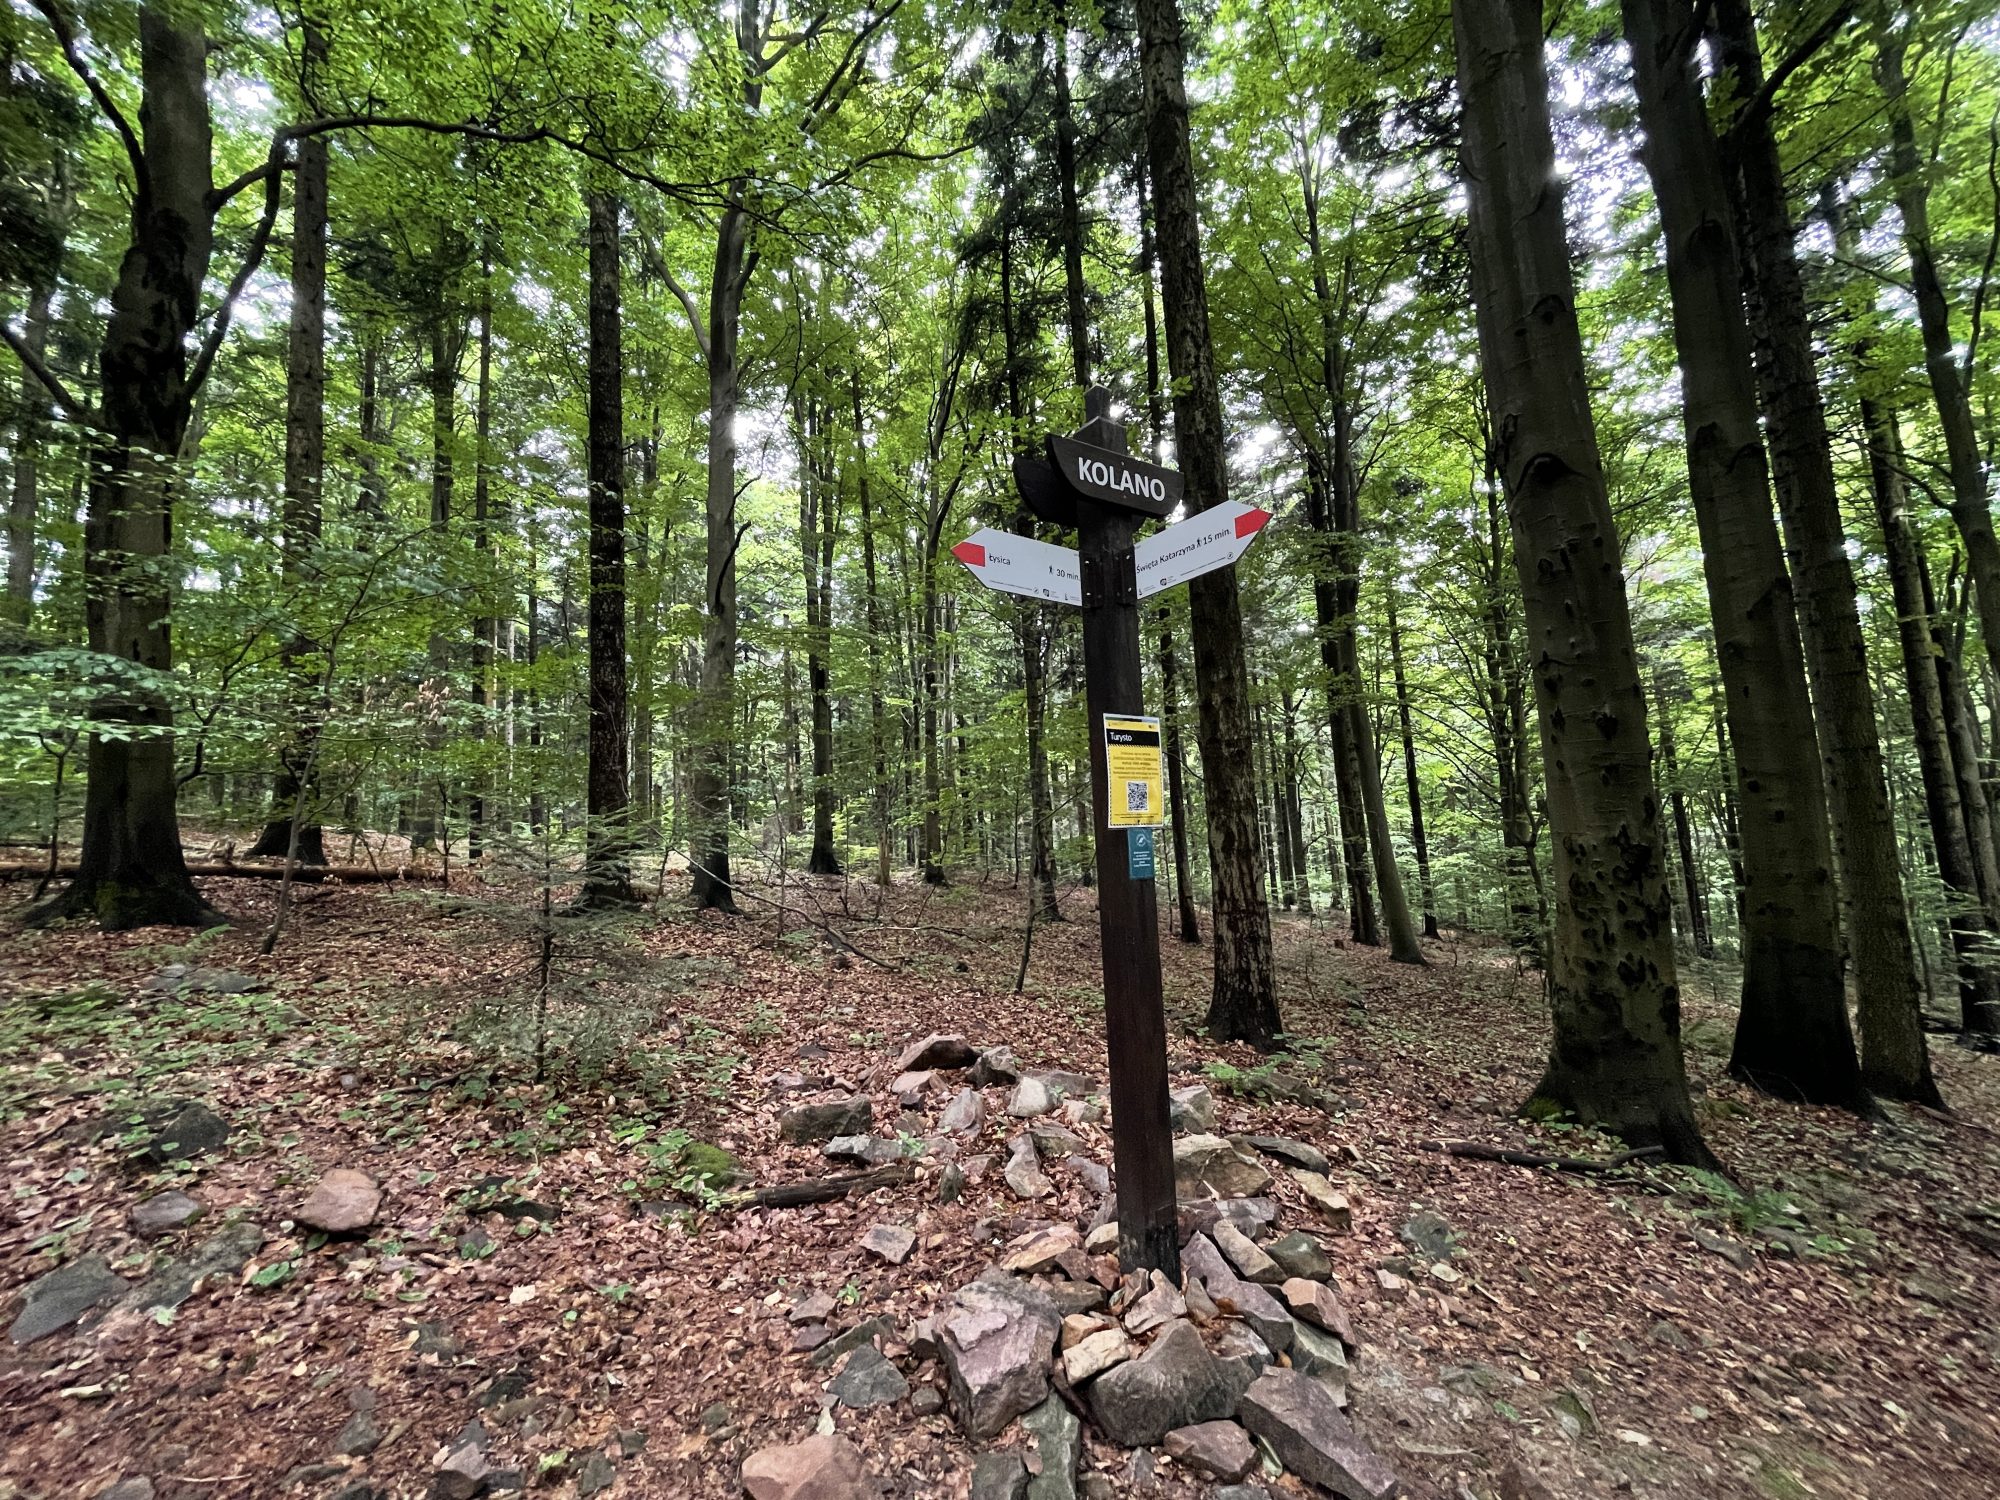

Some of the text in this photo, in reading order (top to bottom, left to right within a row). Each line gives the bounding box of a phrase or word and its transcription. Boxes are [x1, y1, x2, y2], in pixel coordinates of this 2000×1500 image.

[1078, 457, 1166, 502] KOLANO
[1136, 559, 1159, 574] Święta
[1159, 543, 1196, 565] Katarzyna
[1203, 534, 1213, 545] 15
[1056, 568, 1066, 578] 30
[1110, 732, 1133, 742] Turysto
